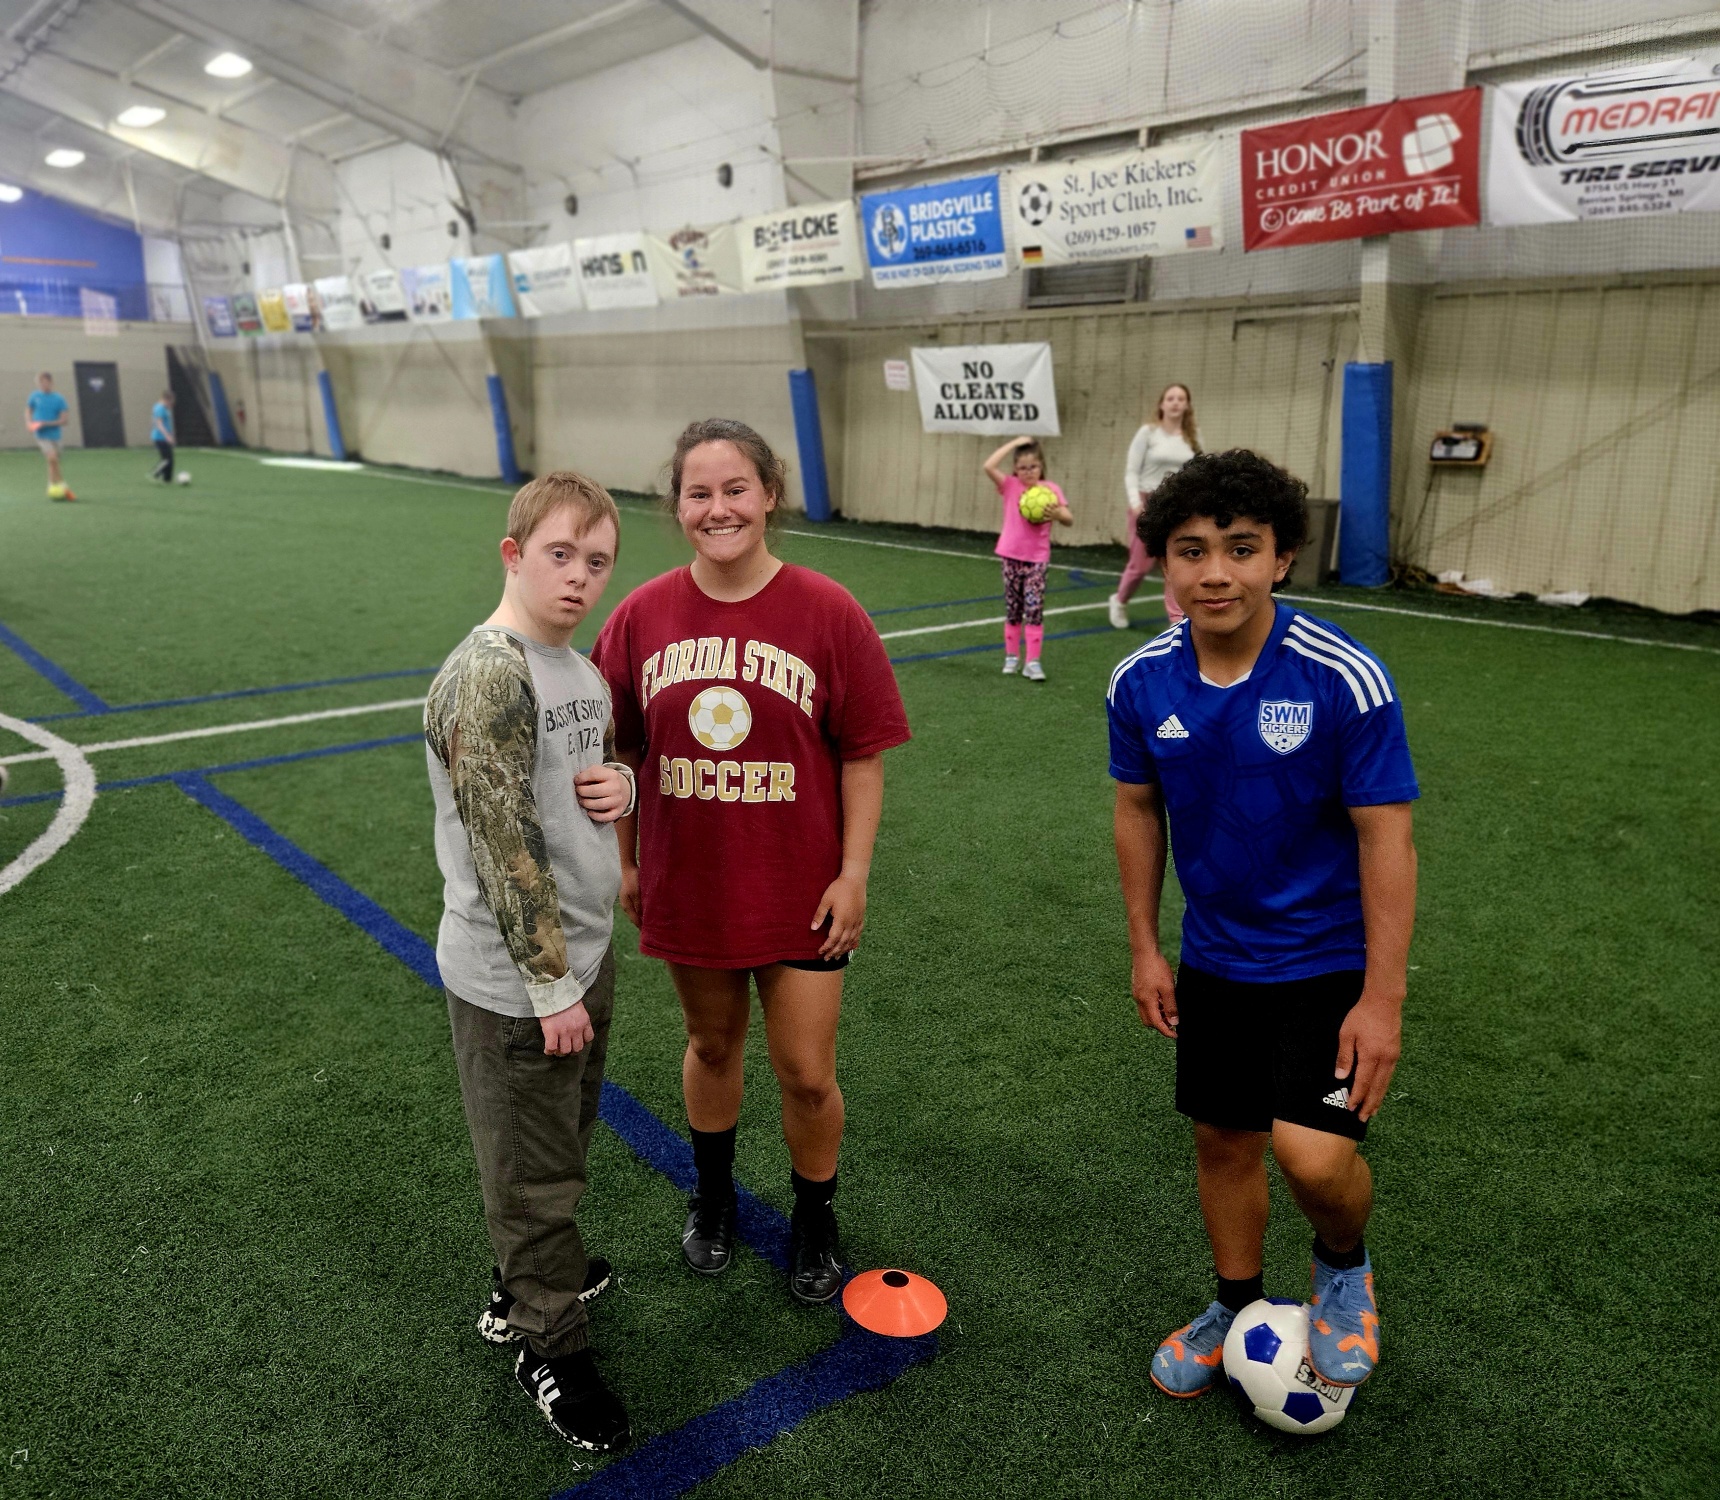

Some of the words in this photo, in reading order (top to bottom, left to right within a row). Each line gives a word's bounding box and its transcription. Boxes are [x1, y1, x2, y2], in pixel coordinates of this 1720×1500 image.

[1256, 129, 1389, 180] HONOR
[1064, 174, 1085, 195] St.
[1088, 171, 1118, 197] Joe
[1125, 159, 1197, 185] Kickers
[1256, 180, 1319, 200] CREDIT
[1329, 170, 1387, 188] UNION
[1560, 163, 1624, 185] TIRE
[1613, 182, 1629, 191] US
[1632, 181, 1658, 190] Hwy
[1286, 205, 1327, 226] Come
[1330, 199, 1354, 221] Be
[1357, 194, 1401, 216] Part
[1404, 186, 1428, 212] of
[1429, 182, 1461, 207] It!
[1668, 188, 1684, 197] MI
[909, 191, 993, 222] BRIDGVILLE
[1059, 197, 1106, 225] Sport
[1112, 189, 1163, 213] Club,
[1167, 186, 1203, 207] Inc.
[911, 216, 977, 242] PLASTICS
[962, 361, 994, 379] NO
[940, 381, 1025, 400] CLEATS
[934, 402, 1039, 421] ALLOWED
[641, 636, 737, 710] FLORIDA
[742, 639, 816, 718] STATE
[1262, 705, 1307, 724] SWM
[1156, 729, 1189, 738] adidas
[1260, 723, 1309, 734] KICKERS
[659, 754, 796, 803] SOCCER
